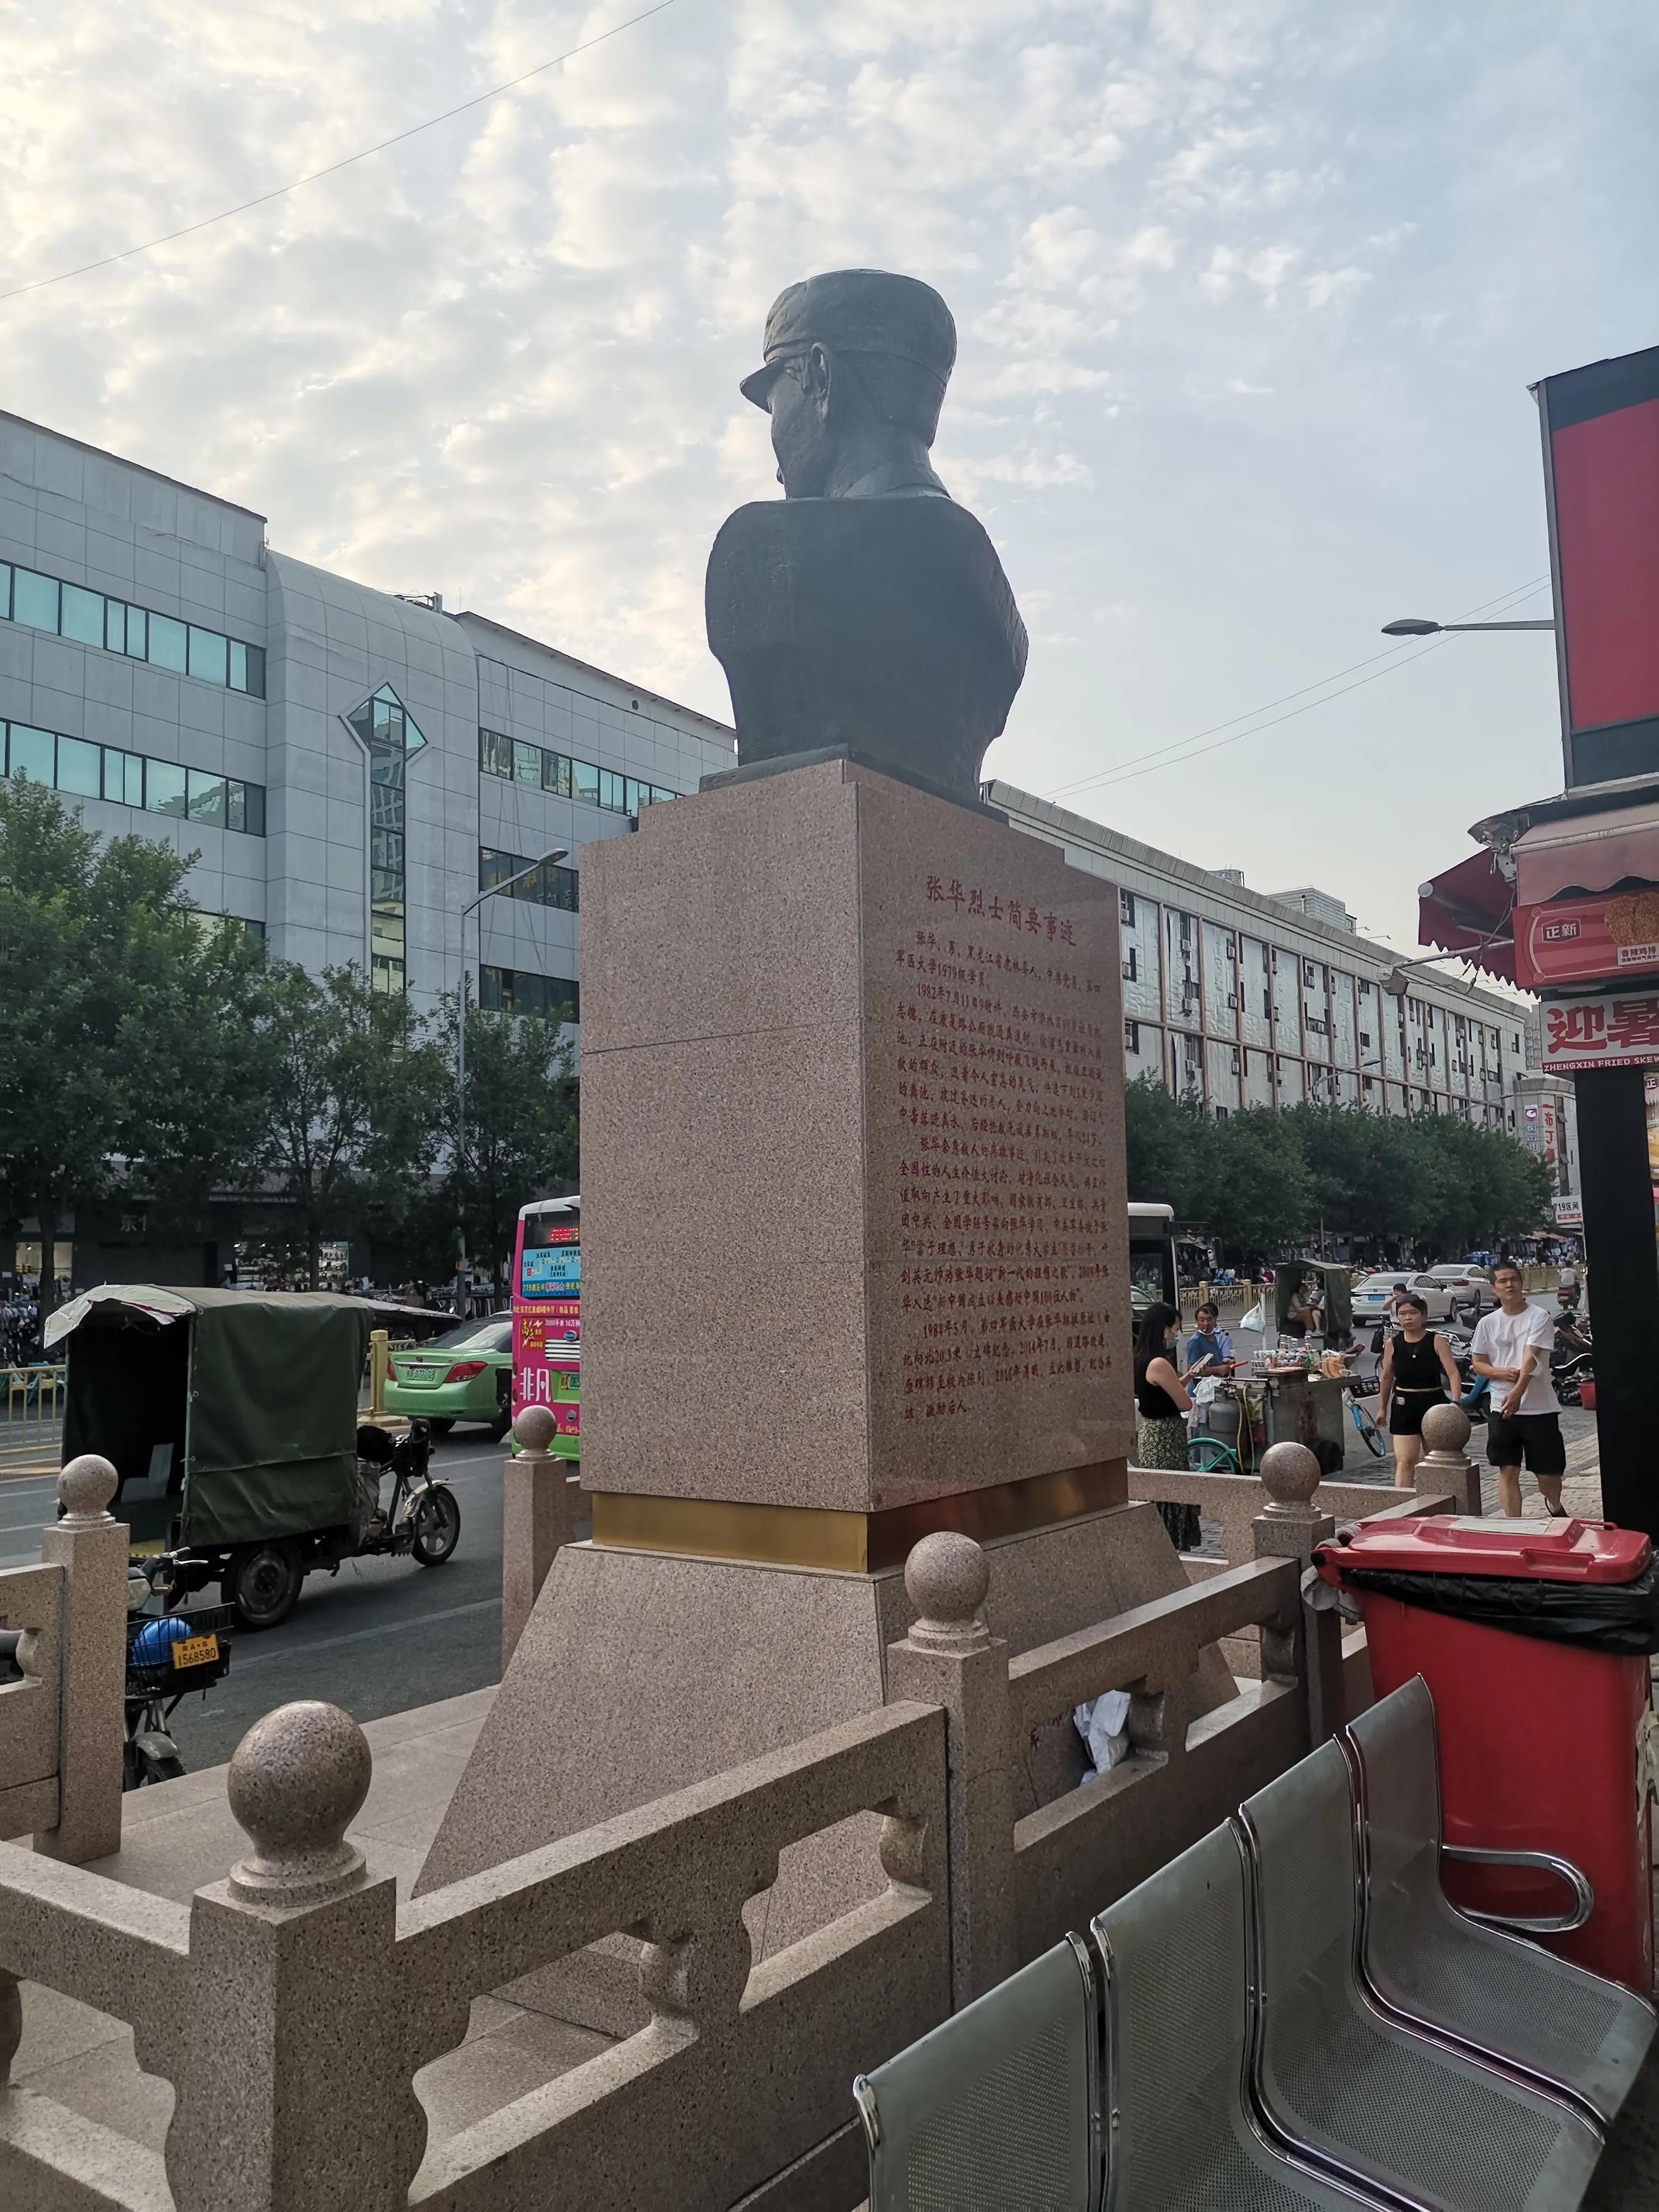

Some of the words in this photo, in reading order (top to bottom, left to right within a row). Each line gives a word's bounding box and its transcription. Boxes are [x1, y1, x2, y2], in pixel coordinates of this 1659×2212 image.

[926, 872, 1076, 948] 张华烈士简要事迹
[1546, 924, 1576, 939] 正新
[896, 948, 990, 991] 军医大学1979级学员。
[1543, 1060, 1595, 1072] ZHENGXIN
[1598, 1058, 1630, 1067] FRIED
[520, 1366, 551, 1403] 非凡
[178, 1648, 216, 1666] 1568580
